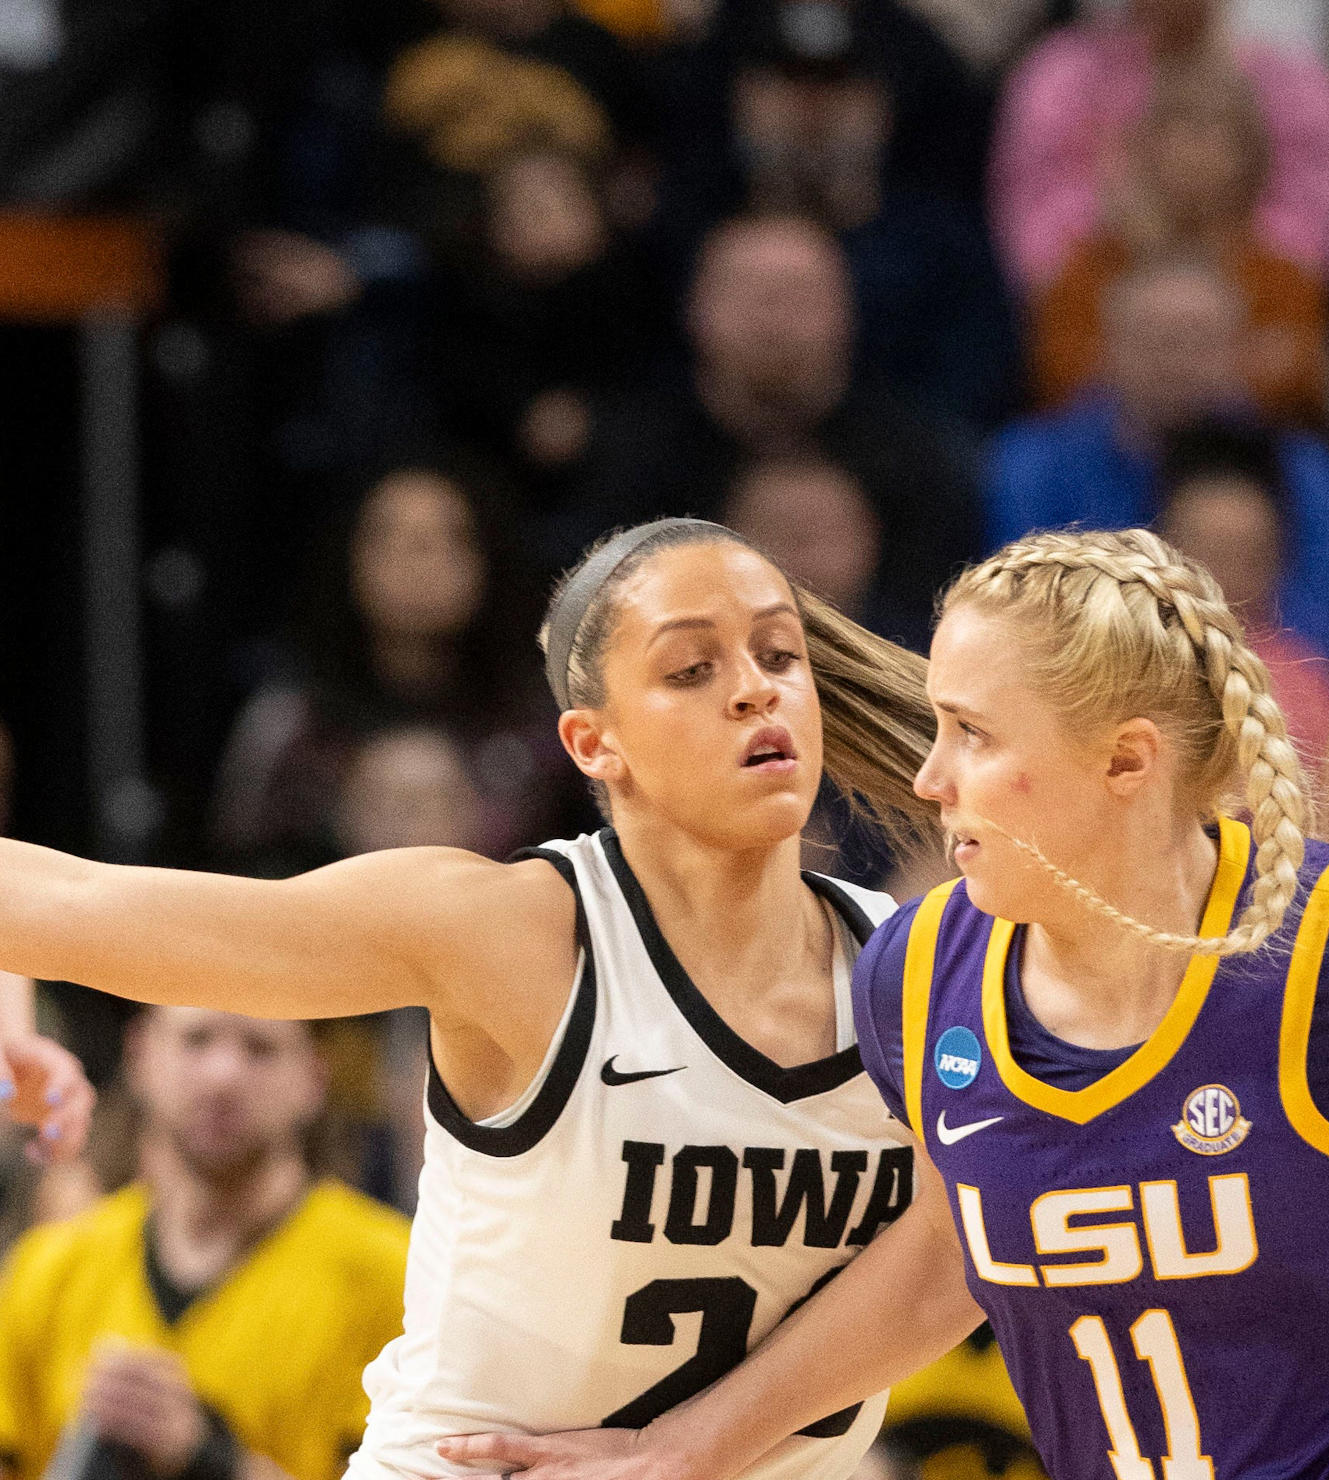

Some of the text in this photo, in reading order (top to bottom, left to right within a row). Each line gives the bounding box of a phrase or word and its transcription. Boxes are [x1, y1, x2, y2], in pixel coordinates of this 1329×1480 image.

[938, 1053, 978, 1076] NCAA
[1188, 1088, 1235, 1137] SEC
[610, 1139, 913, 1249] IOWA
[957, 1173, 1259, 1287] LSU
[601, 1276, 866, 1439] 2
